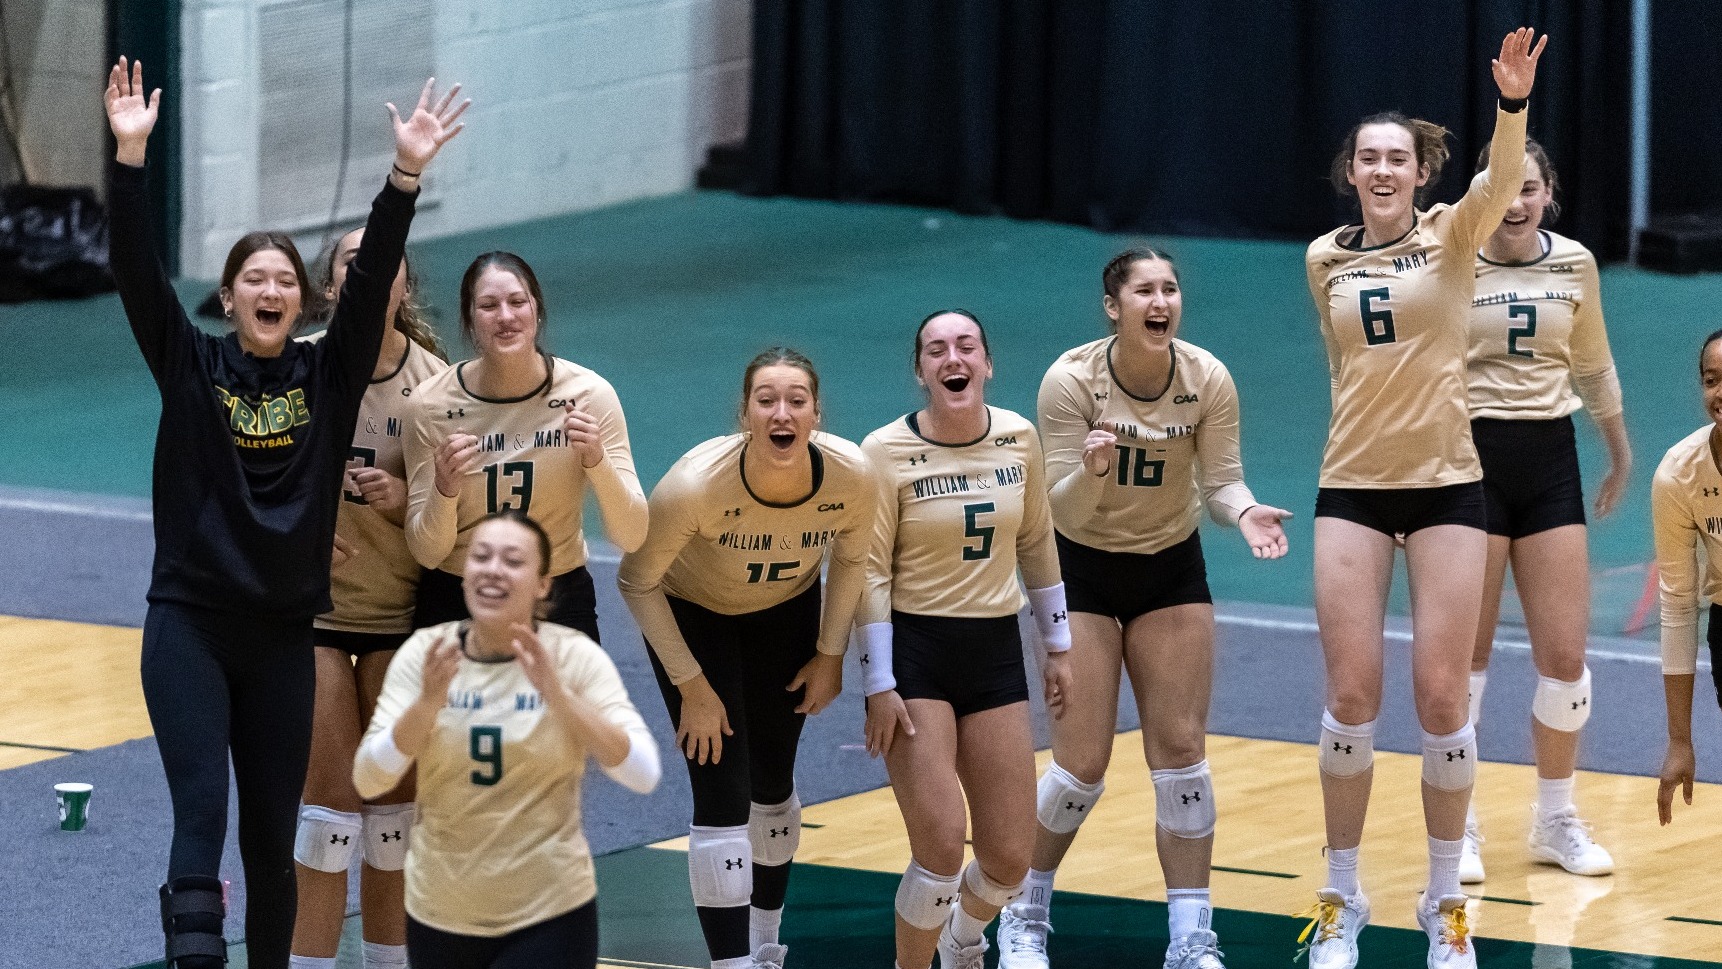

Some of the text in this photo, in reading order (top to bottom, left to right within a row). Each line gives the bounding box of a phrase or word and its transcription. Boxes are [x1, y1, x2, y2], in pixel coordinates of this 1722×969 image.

[1392, 250, 1428, 274] MARY
[1359, 287, 1396, 346] 6
[1508, 305, 1537, 357] 2
[1173, 394, 1198, 405] CAA
[234, 435, 294, 449] OLLEYBALL
[513, 434, 525, 450] &
[994, 436, 1018, 447] CAA
[1115, 444, 1166, 487] 16
[482, 461, 534, 516] 13
[913, 465, 1023, 498] WILLIAM & MARY
[817, 503, 844, 512] CAA
[718, 531, 772, 550] WILLIAM
[780, 535, 791, 550] &
[962, 502, 996, 560] 5
[469, 725, 503, 786] 9
